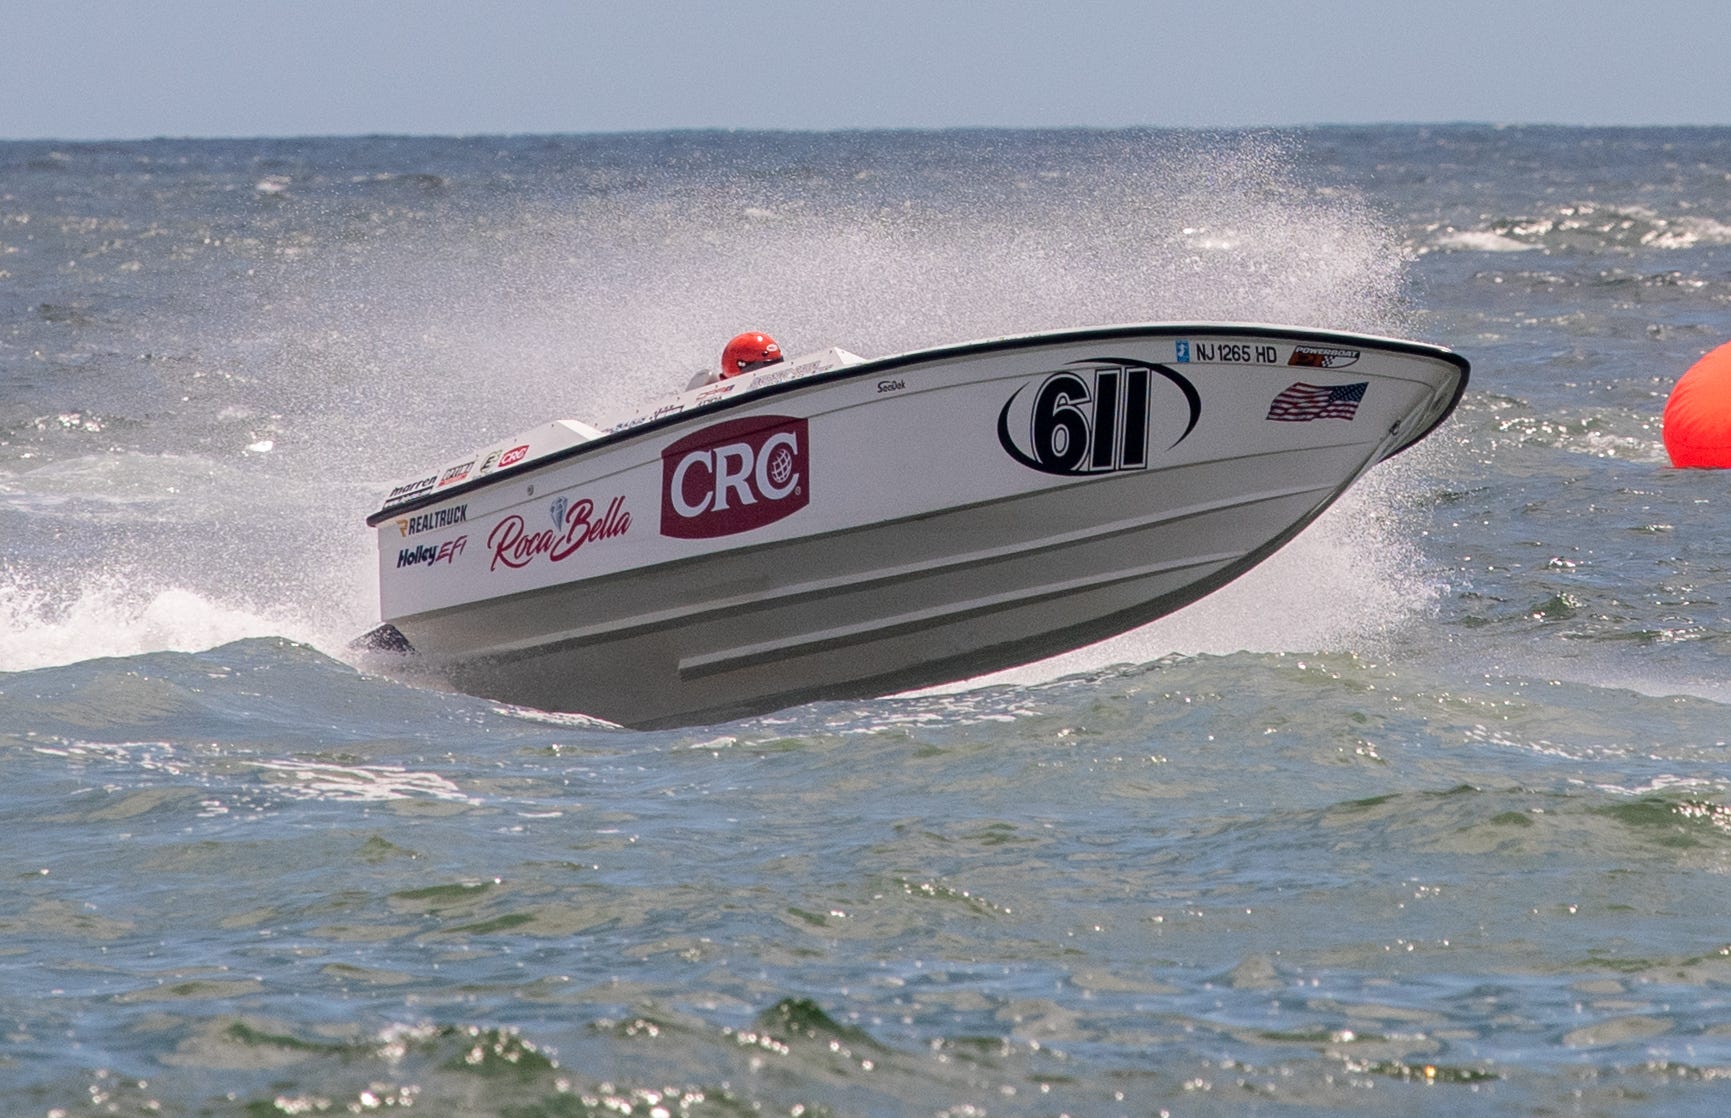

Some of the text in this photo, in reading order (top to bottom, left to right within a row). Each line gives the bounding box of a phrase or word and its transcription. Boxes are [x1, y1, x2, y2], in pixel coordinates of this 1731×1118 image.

[1196, 343, 1277, 364] NJ 1265 HD
[1295, 346, 1358, 357] POWERBOAT
[1030, 367, 1152, 472] 611
[389, 475, 438, 497] marren
[671, 431, 800, 518] CRC
[408, 504, 468, 536] REALTRUCK
[487, 495, 633, 572] Roca Bella
